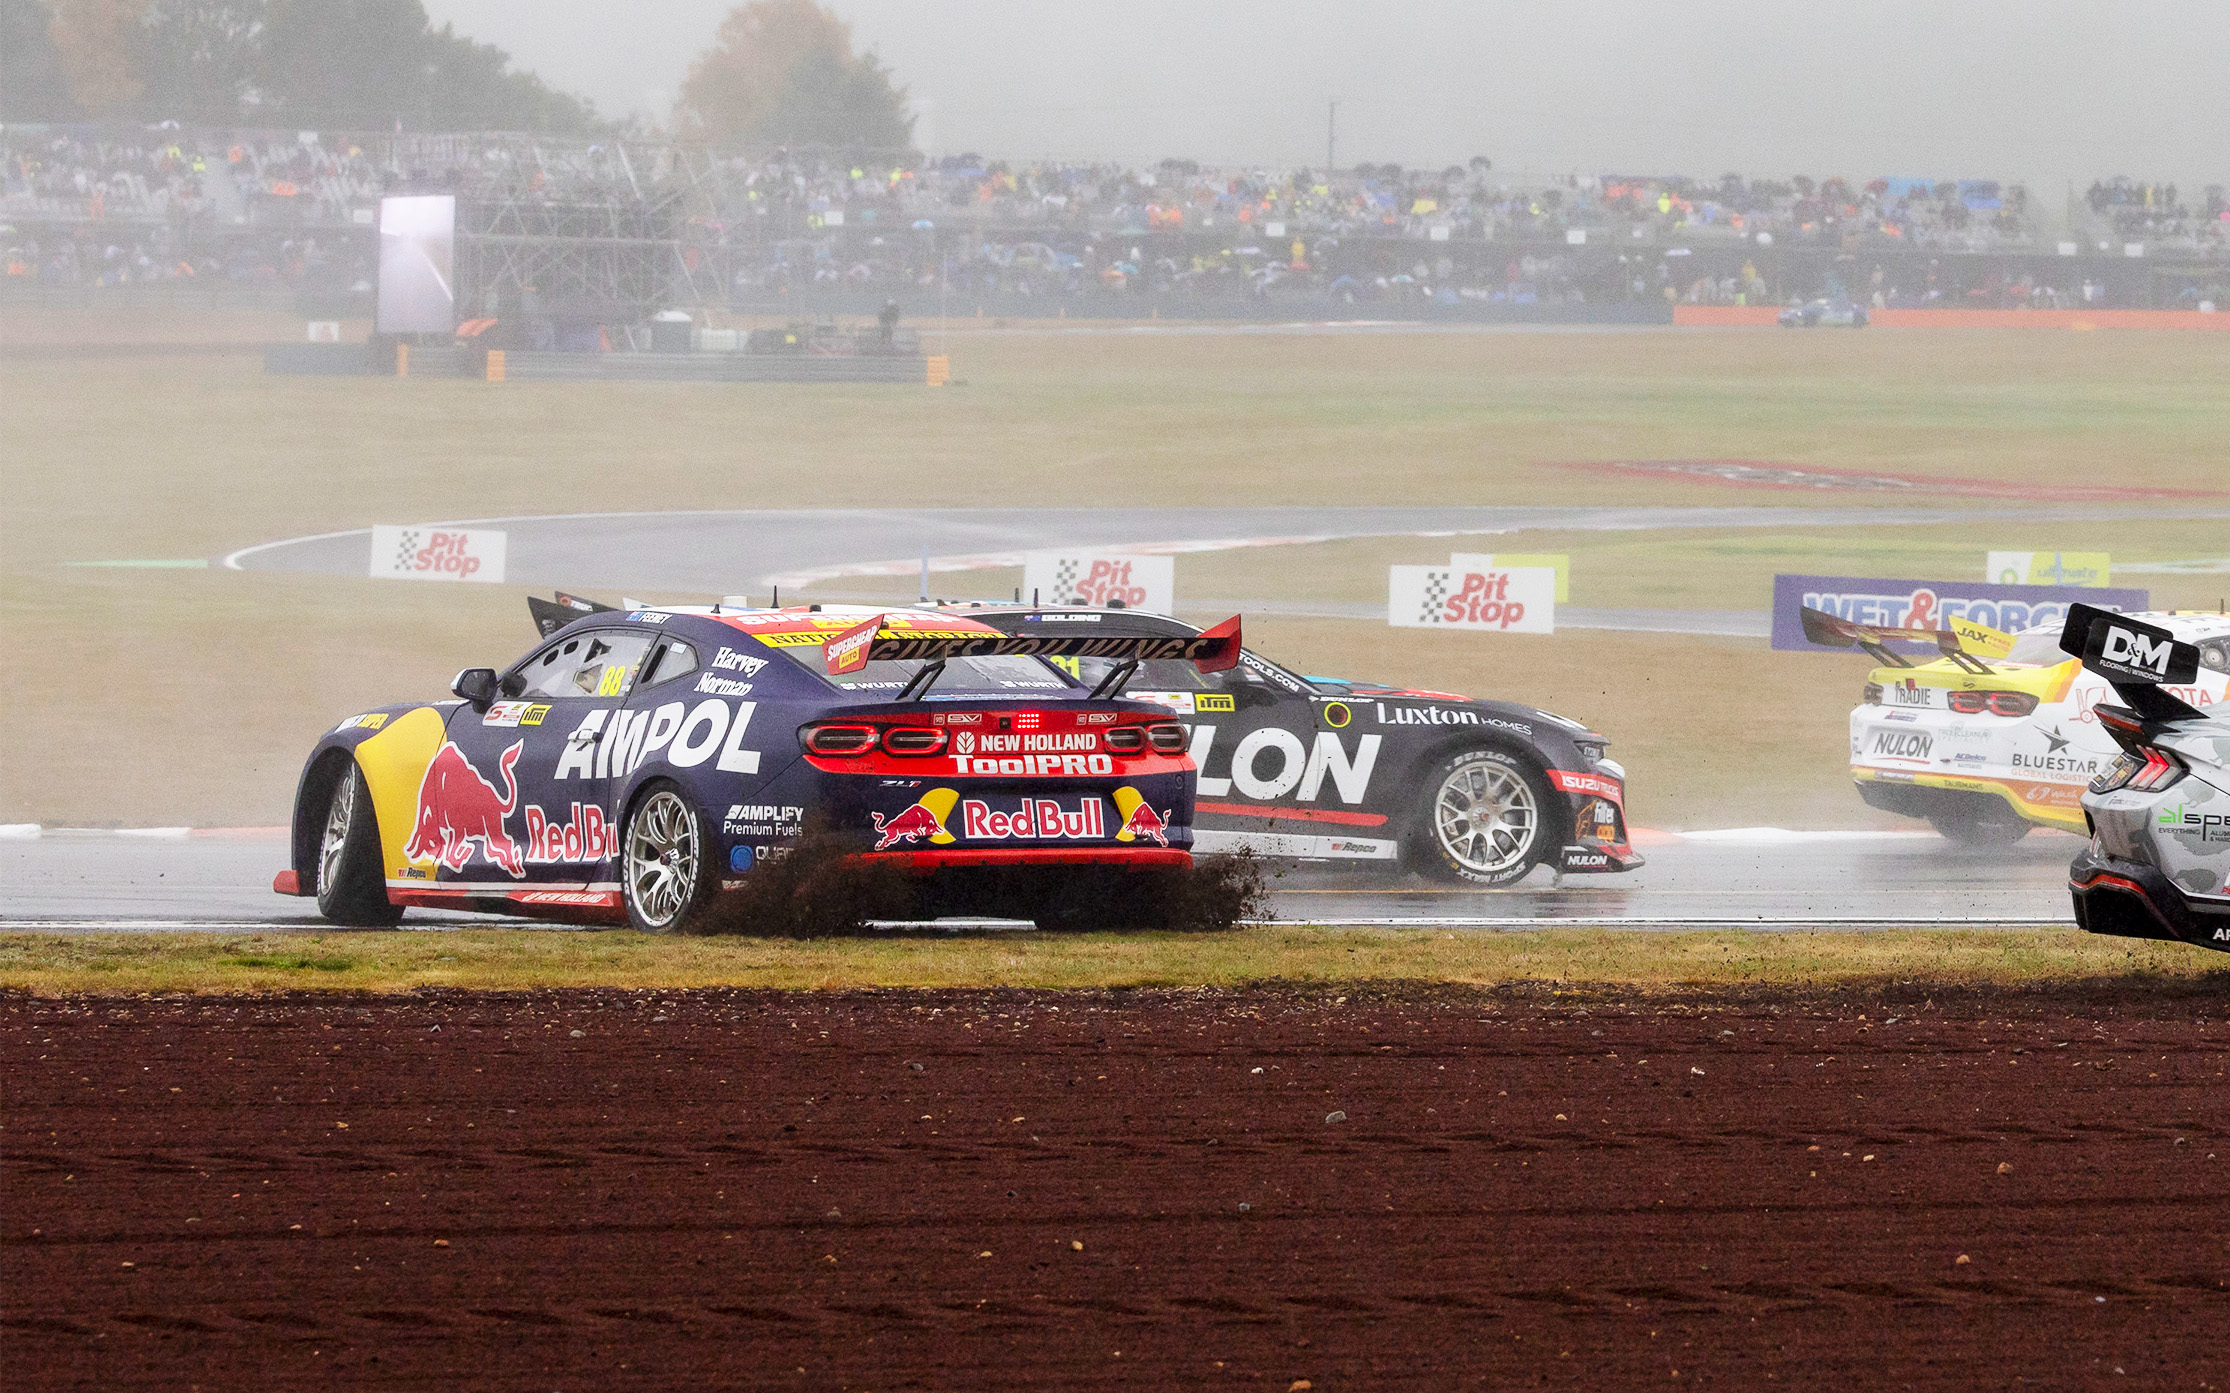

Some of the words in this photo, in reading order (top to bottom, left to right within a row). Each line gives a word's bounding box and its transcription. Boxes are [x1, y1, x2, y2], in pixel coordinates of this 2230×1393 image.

[430, 532, 468, 556] Pit
[415, 548, 480, 578] Stop
[1089, 560, 1132, 587] Pit
[1076, 579, 1146, 608] Stop
[1461, 573, 1509, 602] Pit
[639, 611, 673, 624] FEENEY
[1042, 614, 1102, 622] GOLDING
[1444, 594, 1524, 629] Stop
[828, 626, 878, 661] SUPERCHEAP
[1957, 627, 1988, 643] JAX
[711, 646, 769, 678] Harvey
[841, 652, 858, 665] AUTO
[2102, 626, 2173, 674] D&M
[600, 666, 626, 696] 88
[2100, 659, 2129, 673] FLOORING
[2131, 668, 2164, 683] WINDOWS
[693, 671, 754, 697] Norman
[1895, 681, 1931, 705] TRADIE
[1377, 703, 1479, 725] Luxton
[1481, 717, 1533, 735] HOMES
[554, 698, 762, 780] AMPOL
[981, 735, 1023, 751] NEW
[1027, 734, 1096, 751] HOLLAND
[1874, 733, 1934, 758] NULON
[949, 754, 1113, 774] ToolPRO
[1187, 724, 1382, 804] LON
[2011, 768, 2047, 779] GLOBAL
[2051, 770, 2092, 782] LOGISTIC
[2012, 753, 2098, 773] BLUESTAR
[1562, 776, 1600, 790] ISUZU
[738, 805, 804, 821] AMPLIFY
[723, 821, 772, 836] Premium
[775, 823, 803, 837] Fuels
[1342, 842, 1377, 853] Repco
[1567, 855, 1608, 866] NULON
